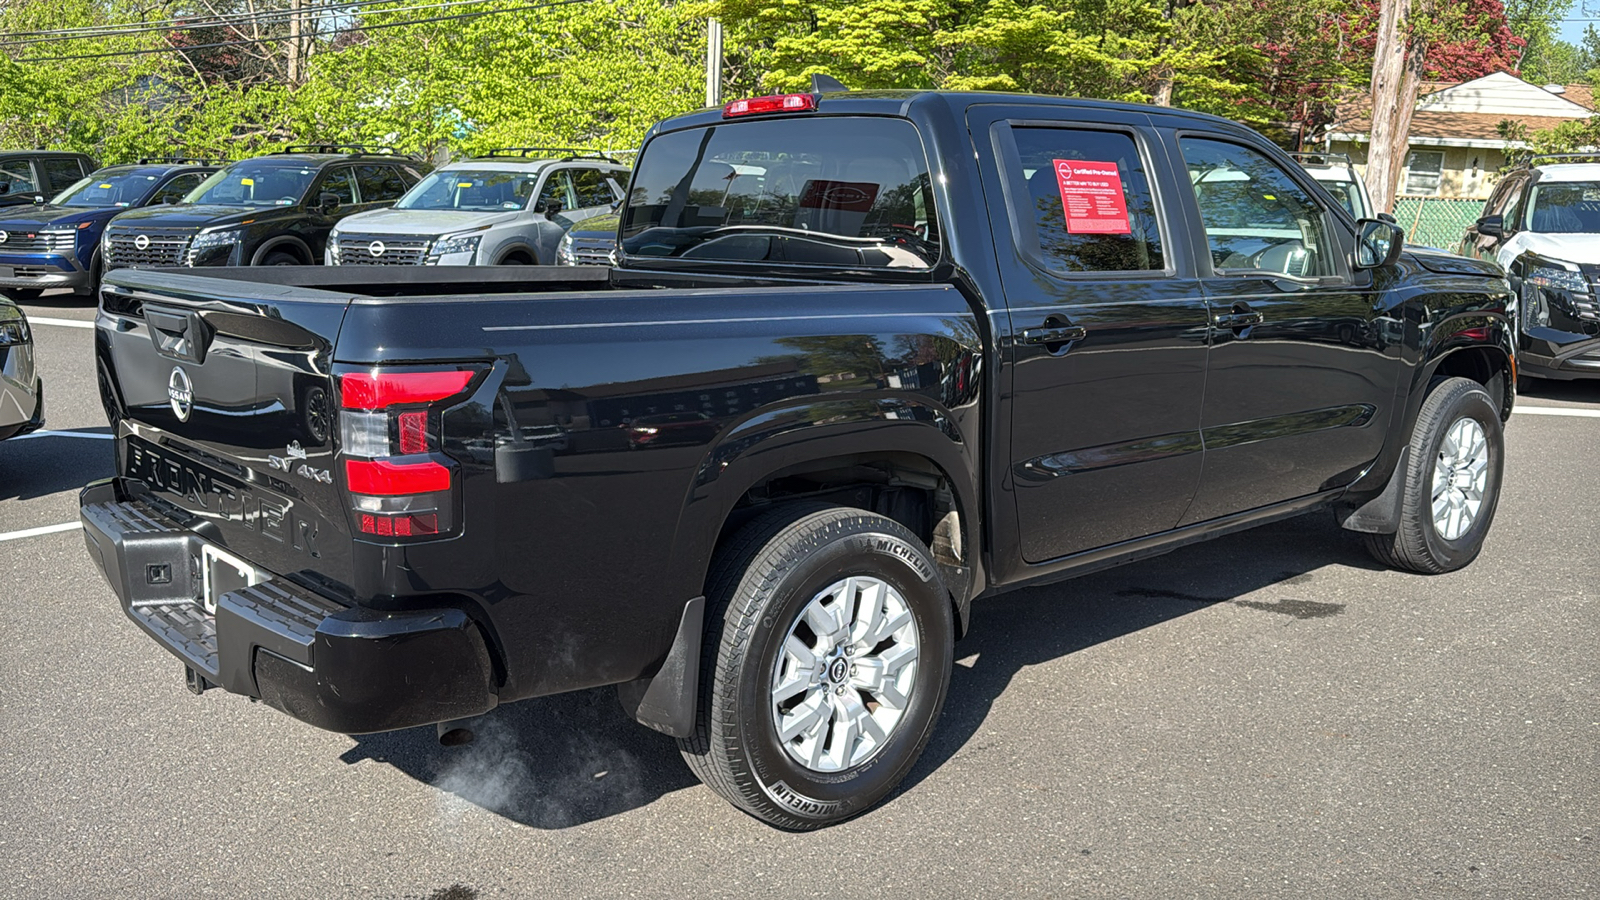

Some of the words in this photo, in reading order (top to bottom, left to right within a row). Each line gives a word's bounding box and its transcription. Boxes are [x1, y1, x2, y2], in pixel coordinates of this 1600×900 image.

[167, 387, 192, 403] ISSAN
[268, 454, 292, 473] SV
[128, 441, 321, 558] FRONTIER
[876, 540, 931, 578] MICHELIN
[773, 784, 838, 815] MICHELIN
